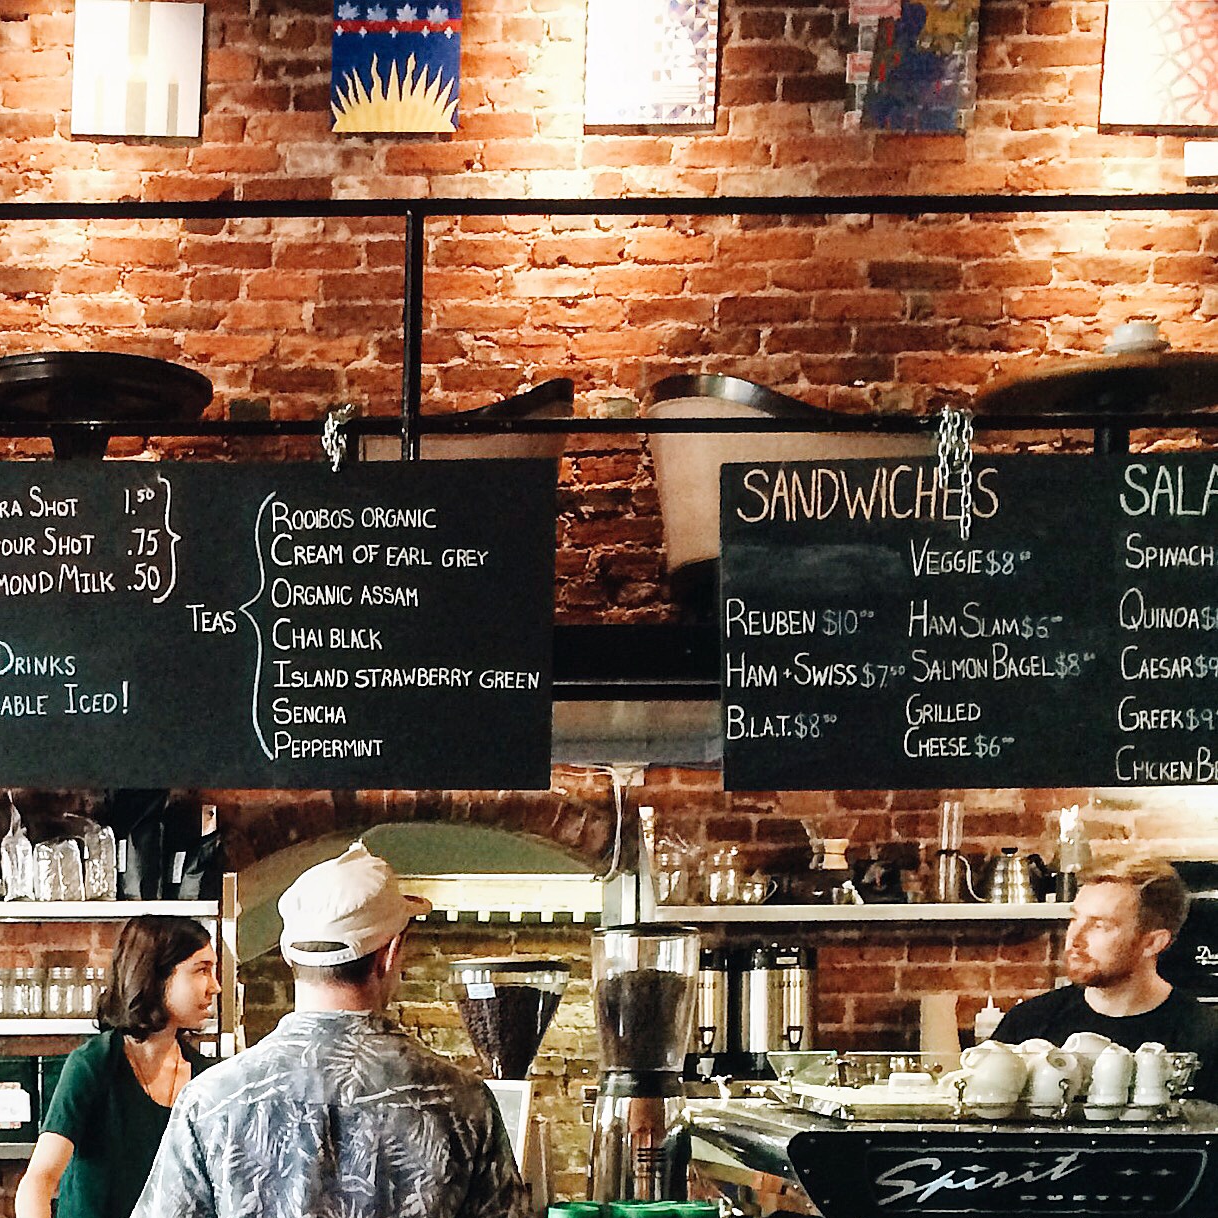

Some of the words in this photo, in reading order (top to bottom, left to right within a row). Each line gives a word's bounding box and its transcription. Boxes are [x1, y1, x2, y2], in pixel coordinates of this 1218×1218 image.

[29, 486, 79, 518] SHOT
[124, 487, 155, 515] 1.50
[736, 465, 1000, 522] SANDWICHES
[272, 502, 354, 532] ROOIBOS
[361, 507, 437, 529] ORGANIC
[42, 527, 95, 556] SHOT
[126, 528, 161, 556] .75
[271, 533, 343, 567] CREAM
[352, 544, 381, 565] OF
[386, 547, 433, 567] EARL
[441, 549, 489, 568] GREY
[910, 538, 983, 577] VEGGIE
[1125, 532, 1215, 569] SPINACH
[57, 563, 116, 594] MILK
[126, 563, 161, 591] .50
[271, 578, 353, 608] ORGANIC
[360, 585, 419, 608] ASSAM
[185, 603, 237, 634] TEAS
[726, 598, 816, 638] REUBEN
[909, 599, 956, 638] HAM
[960, 601, 1020, 638] SLAM
[1119, 587, 1200, 632] QUINOA
[272, 618, 323, 650] CHAI
[330, 629, 383, 650] BLACK
[272, 660, 349, 689] ISLAND
[354, 668, 473, 688] STRAWBERRY
[479, 669, 540, 690] GREEN
[726, 652, 777, 688] HAM
[793, 652, 858, 687] SWISS
[911, 649, 988, 683] SALMON
[991, 642, 1055, 681] BAGEL
[1121, 645, 1194, 681] CAESAR
[64, 681, 130, 715] ICED!
[272, 697, 347, 725] SENCHA
[906, 693, 981, 727] GRILLED
[1117, 696, 1184, 732] GREEK
[274, 731, 384, 759] PEPPERMINT
[904, 727, 972, 758] CHEESE
[1115, 745, 1193, 781] CHICKEN
[876, 1151, 1085, 1206] Spirit
